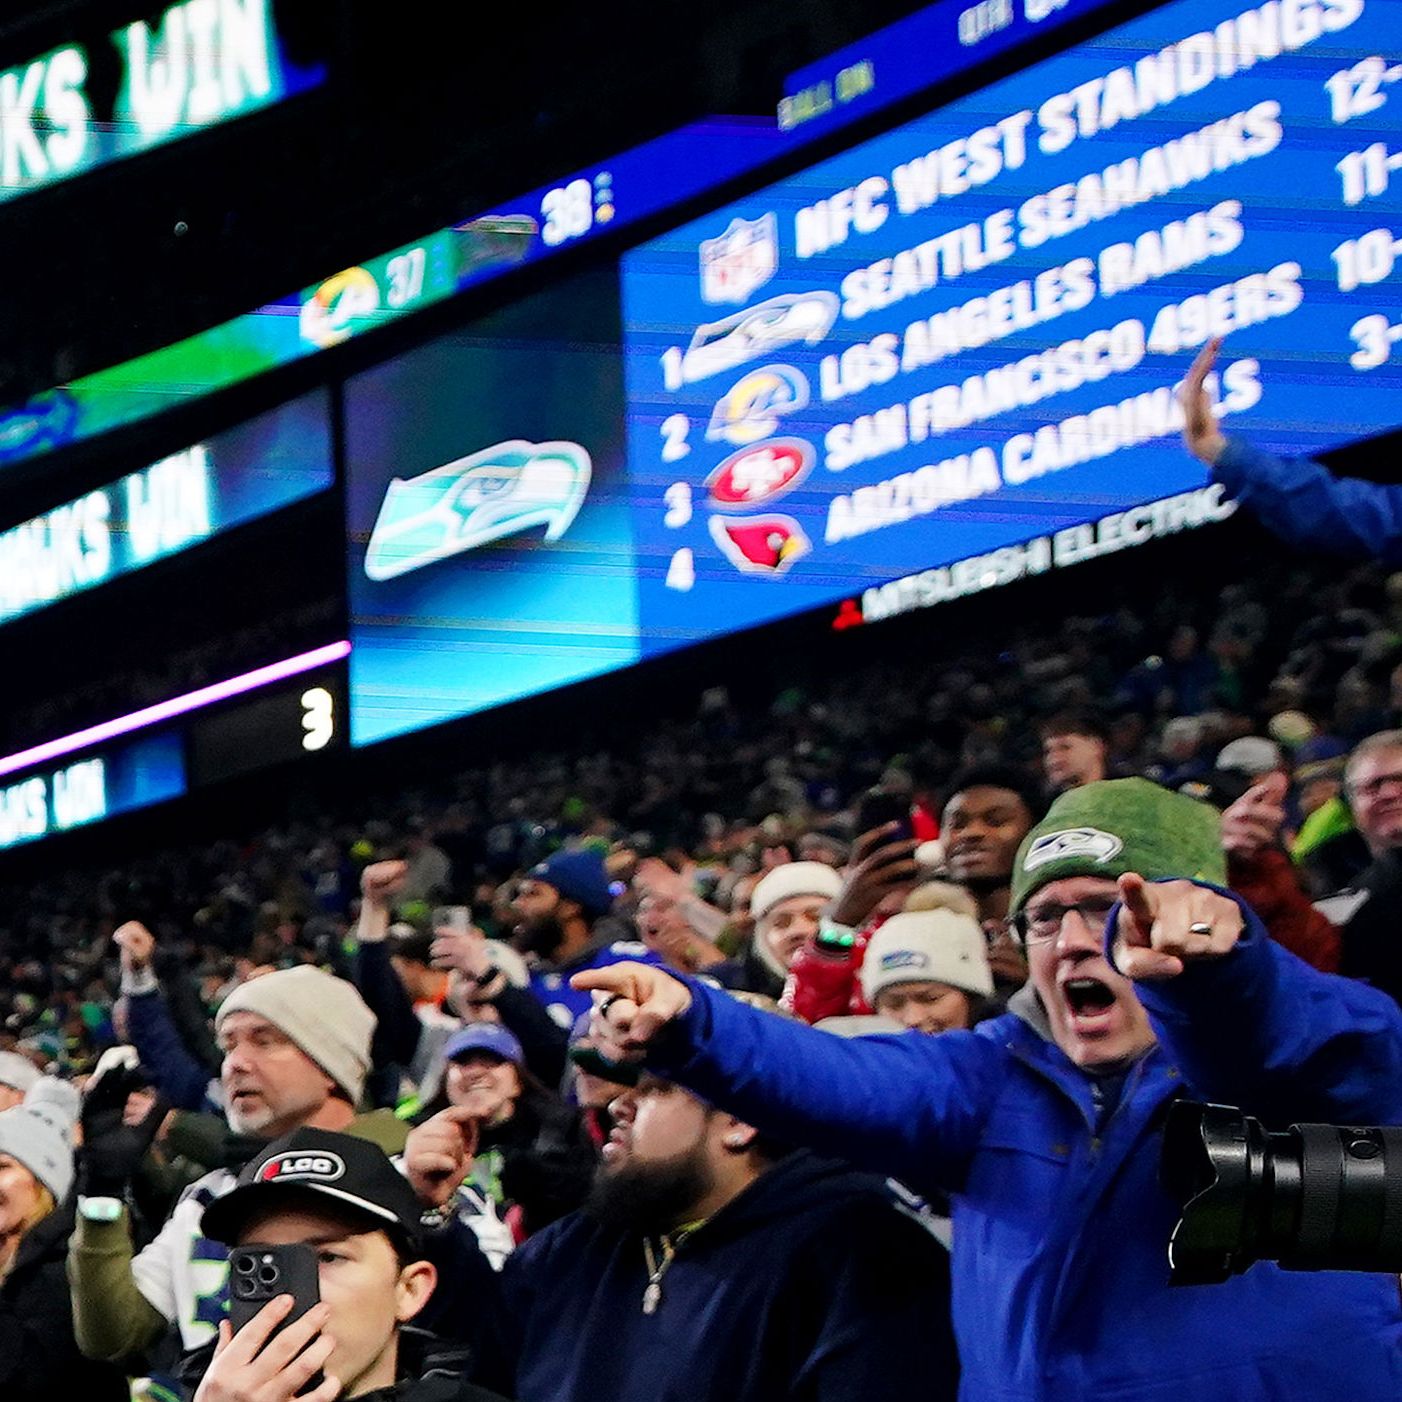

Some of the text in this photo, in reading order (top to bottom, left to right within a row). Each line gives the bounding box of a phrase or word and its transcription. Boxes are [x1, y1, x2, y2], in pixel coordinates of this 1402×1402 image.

[128, 0, 272, 137] WIN
[795, 0, 1365, 258] NFC WEST STANDINGS
[660, 413, 691, 462] 2
[820, 333, 899, 400] LOS
[901, 257, 1095, 372] ANGELES
[1098, 200, 1244, 297] RAMS
[661, 346, 683, 391] 1
[841, 208, 1016, 320] SEATTLE
[1018, 100, 1282, 248] SEAHAWKS
[664, 481, 692, 528] 3
[824, 403, 908, 472] SAN
[909, 319, 1144, 444] FRANCISCO
[1147, 262, 1304, 353] 49ERS
[666, 547, 695, 592] 4
[824, 446, 1003, 544] ARIZONA
[1054, 482, 1239, 568] ELECTRIC
[302, 686, 334, 751] 3
